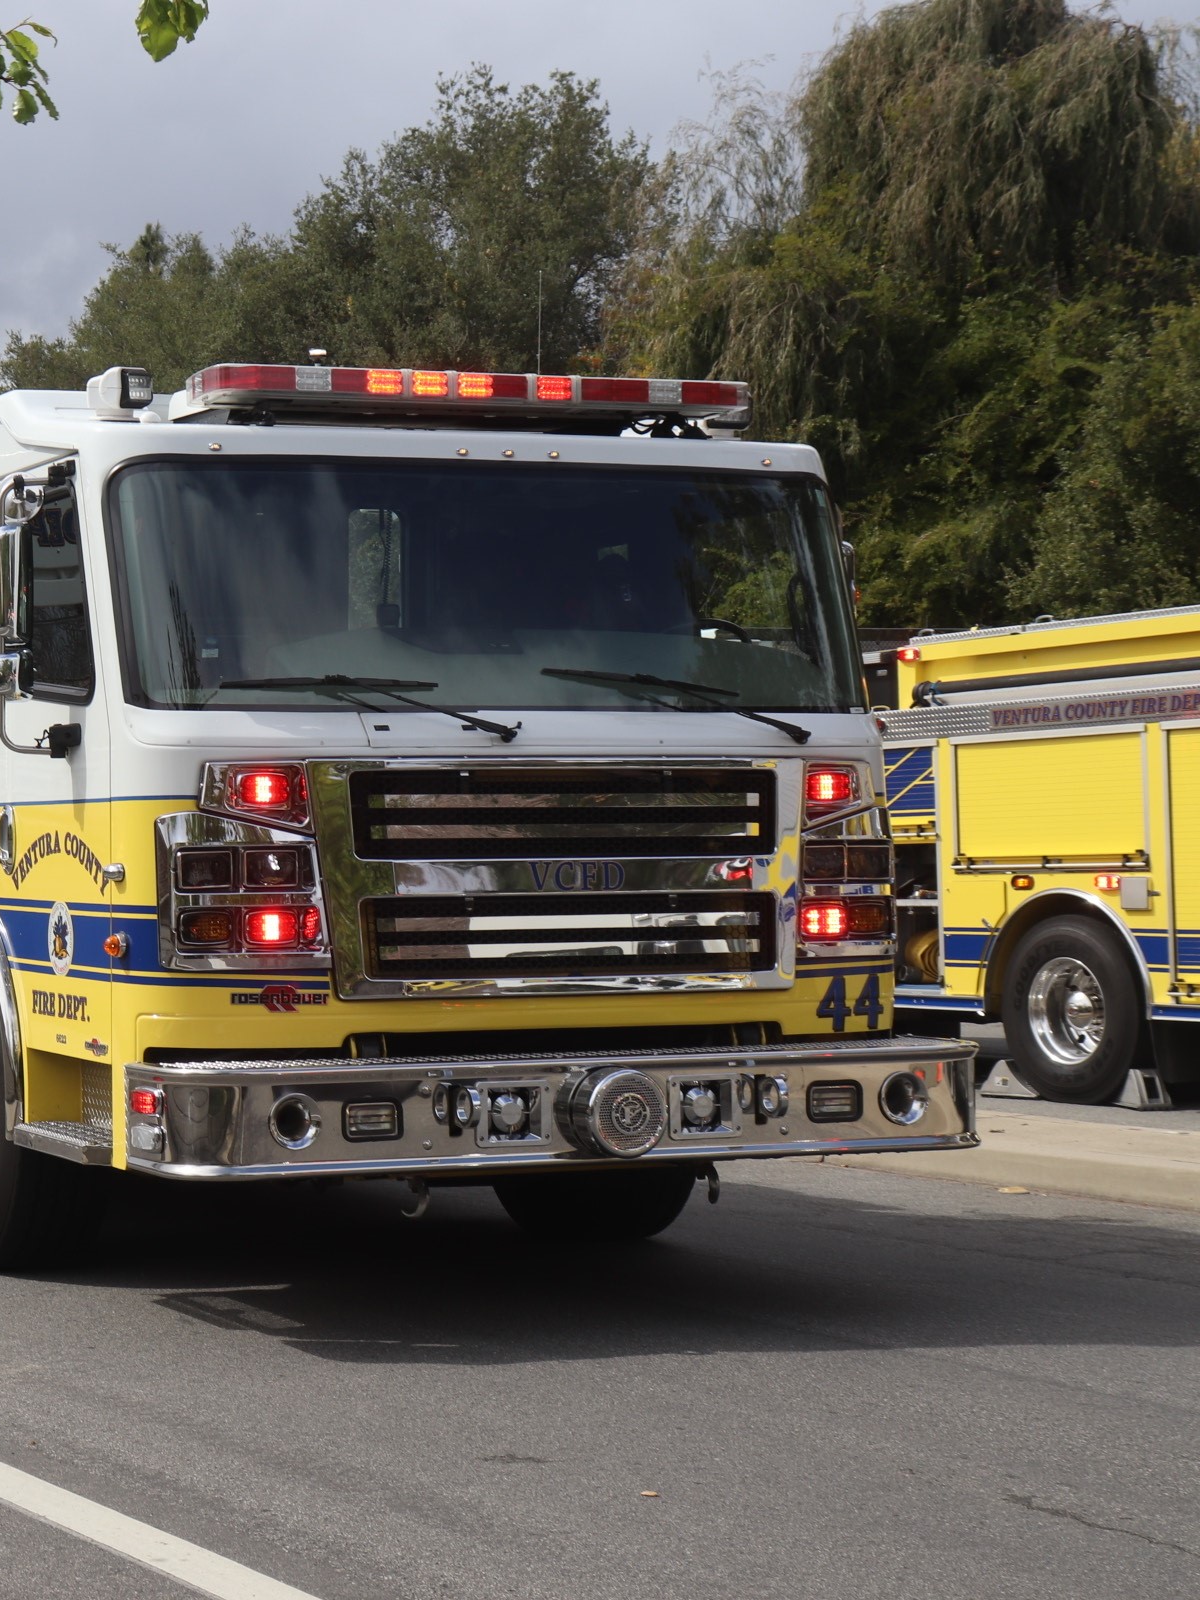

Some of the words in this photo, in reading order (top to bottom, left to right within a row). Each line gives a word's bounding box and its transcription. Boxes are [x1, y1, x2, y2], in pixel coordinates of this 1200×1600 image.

[992, 704, 1062, 727] VENTURA
[1065, 699, 1131, 720] COUNTY
[1131, 695, 1167, 715] FIRE
[11, 830, 61, 891] VENTURA
[528, 860, 625, 891] VCFD
[32, 989, 56, 1017] FIRE
[57, 993, 90, 1022] DEPT.
[230, 989, 329, 1006] rosenbauer
[816, 973, 884, 1032] 44
